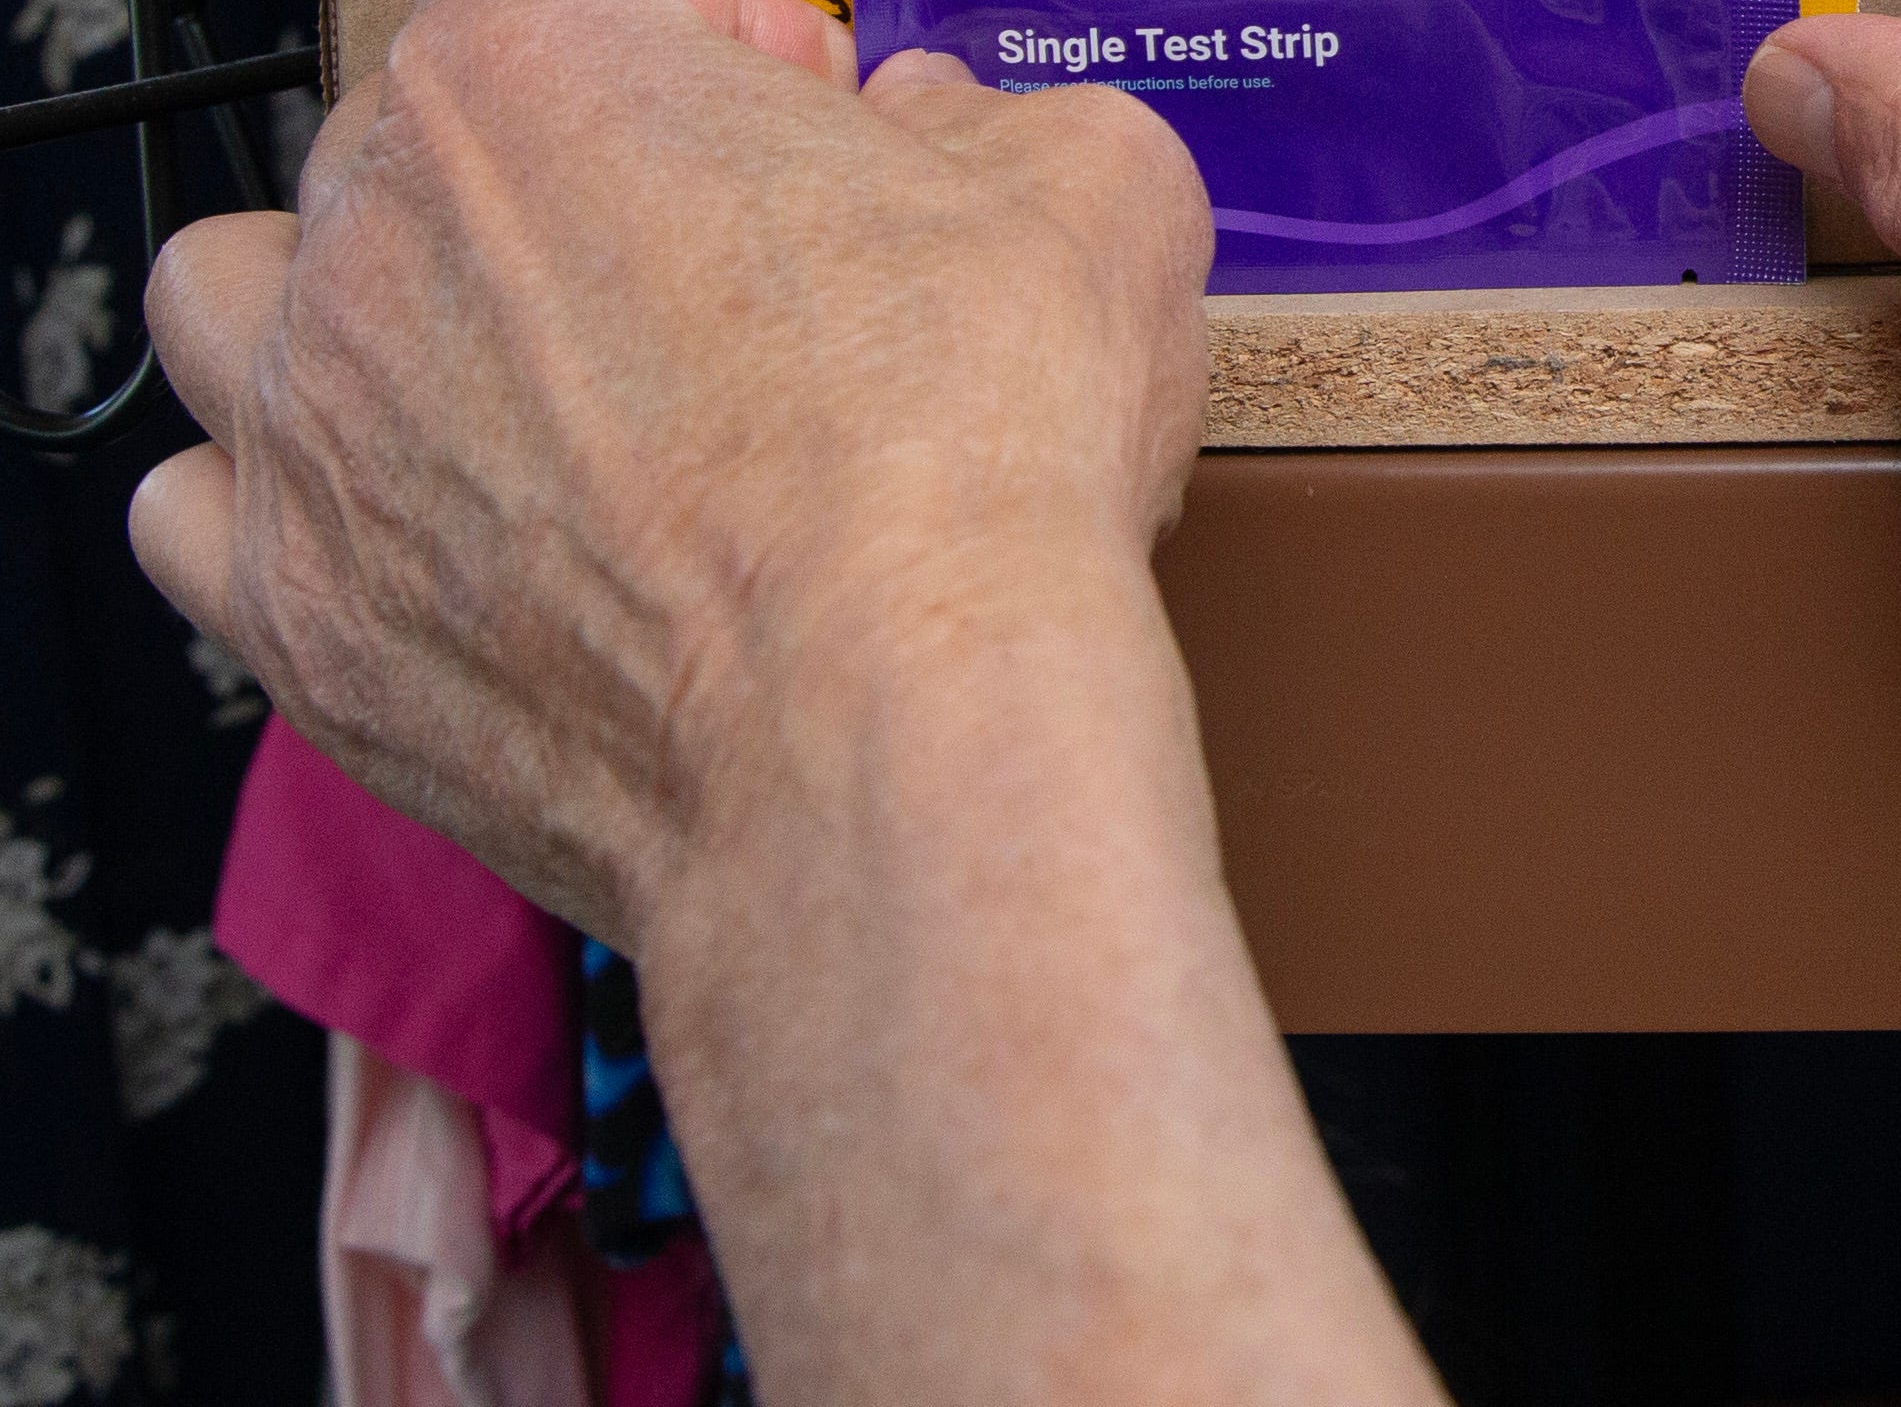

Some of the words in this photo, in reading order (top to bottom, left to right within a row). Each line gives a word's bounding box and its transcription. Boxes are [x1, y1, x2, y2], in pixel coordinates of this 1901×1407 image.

[997, 27, 1126, 73] Single
[1135, 27, 1229, 62] Test
[1239, 23, 1340, 67] Strip
[1092, 76, 1185, 91] structions
[1188, 75, 1239, 90] before
[1242, 77, 1275, 89] use.
